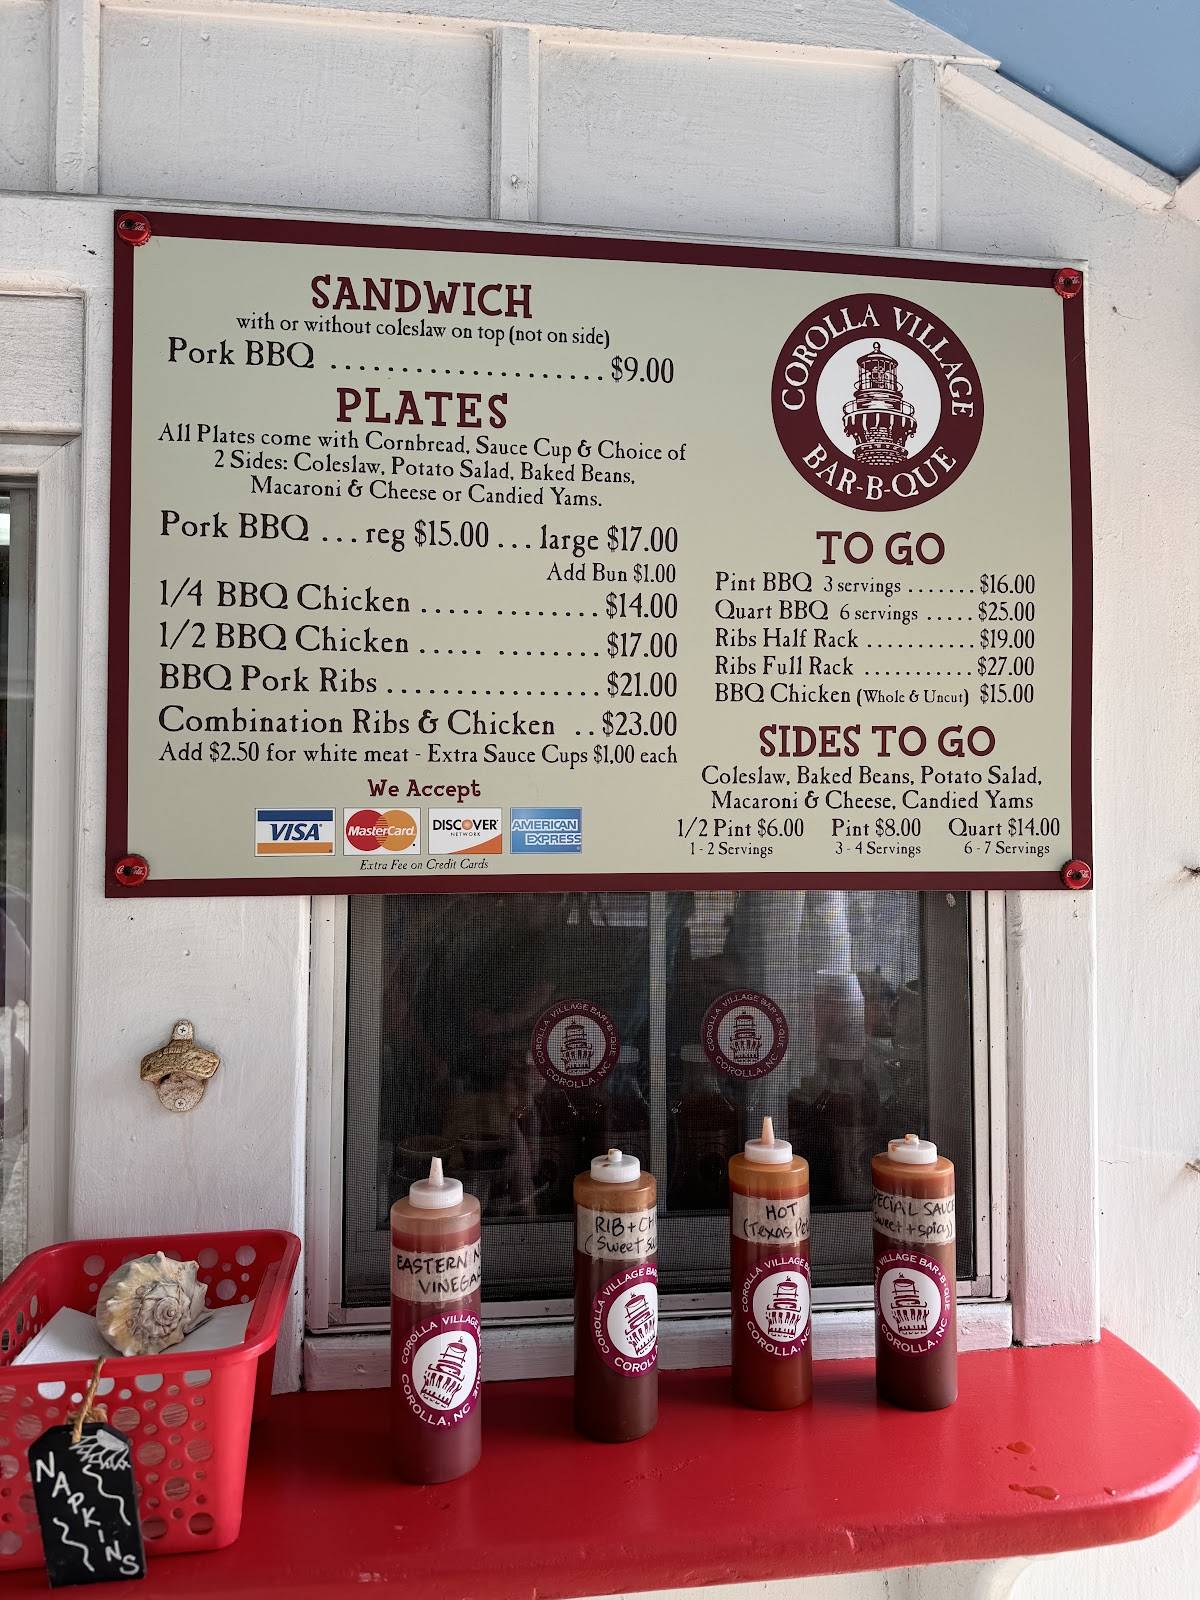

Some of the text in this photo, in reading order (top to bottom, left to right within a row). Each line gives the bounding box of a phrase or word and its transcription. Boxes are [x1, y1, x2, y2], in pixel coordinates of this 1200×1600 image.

[311, 274, 532, 319] SANDWICH
[236, 312, 609, 349] with without coleslaw top (not side)
[168, 337, 674, 383] Pork BBQ $9.00
[782, 304, 974, 417] COROLLA VILLAGE
[335, 387, 507, 433] PLATES
[158, 423, 662, 463] All Plates come with Cornbread, Sauce Cup Choice
[230, 450, 635, 484] Sides: Coleslaw, Potato Salad, Baked Beans,
[802, 443, 957, 500] BAR-B-QUE
[251, 475, 602, 506] Macaroni Cheese Candied Yams.
[160, 510, 678, 558] Pork BBQ reg $15.00 large $17.00
[816, 531, 945, 565] TO GO
[547, 562, 676, 583] Add Bun $1.00
[716, 572, 1035, 597] Pint BBQ servings $16.00
[160, 577, 677, 619] 1/4 BBQ Chicken $14.00
[715, 599, 1035, 625] Quart BBQ servings $25.00
[160, 619, 677, 659] 1/2 BBQ Chicken $17.00
[716, 628, 1034, 650] Ribs Half Rack $19.00
[715, 656, 1034, 677] Ribs Full Rack $27.00
[160, 663, 677, 698] BBQ Pork Ribs $21.00
[715, 683, 1034, 707] BBQ Chicken (Whole Uncut) $15.00
[159, 705, 677, 737] Combination Ribs Chicken $23.00
[760, 724, 995, 757] SIDES TO GO
[158, 741, 202, 761] Add
[210, 741, 259, 762] $2.50
[266, 743, 296, 761] for
[303, 743, 357, 761] white
[364, 749, 408, 762] meat
[428, 744, 477, 762] Extra
[484, 744, 535, 762] Sauce
[542, 744, 588, 769] Cups
[641, 745, 677, 763] each
[702, 765, 1041, 785] Coleslaw, Baked Beans, Potato Salad,
[368, 779, 481, 803] We Accept
[712, 790, 1033, 810] Macaroni Cheese, Candied Yams
[270, 824, 320, 841] VISA
[348, 825, 414, 836] MasterCard
[433, 819, 497, 831] DISCOVER
[511, 819, 577, 831] AMERICAN
[678, 817, 804, 838] 1/2 Pint $6.00
[832, 818, 921, 837] Pint $8.00
[949, 818, 1060, 837] Quart $14.00
[525, 834, 581, 846] EXPRESS
[718, 842, 773, 858] Servings
[867, 841, 921, 858] Servings
[996, 841, 1049, 858] Servings
[360, 858, 489, 870] Extra Fee Credit Cards
[536, 1003, 588, 1064] COROLLA VILLAGE
[708, 993, 758, 1051] COROLLA VILLAGE
[766, 1202, 798, 1220] HOT
[595, 1217, 624, 1237] RIB
[744, 1219, 792, 1239] (Texas
[585, 1235, 644, 1254] (Sweet
[397, 1255, 467, 1275] EASTERN
[879, 1253, 917, 1266] VILLAGE
[742, 1256, 804, 1312] COROLLA VILLAGE
[594, 1268, 644, 1353] COROLLA VILLAGE
[402, 1314, 478, 1364] COROLLA VILLAGE
[747, 1321, 800, 1357] COROLLA,
[881, 1318, 947, 1353] COROLLA, NC
[402, 1374, 471, 1426] COROLLA, NC
[36, 1451, 139, 1575] NAPKINS
